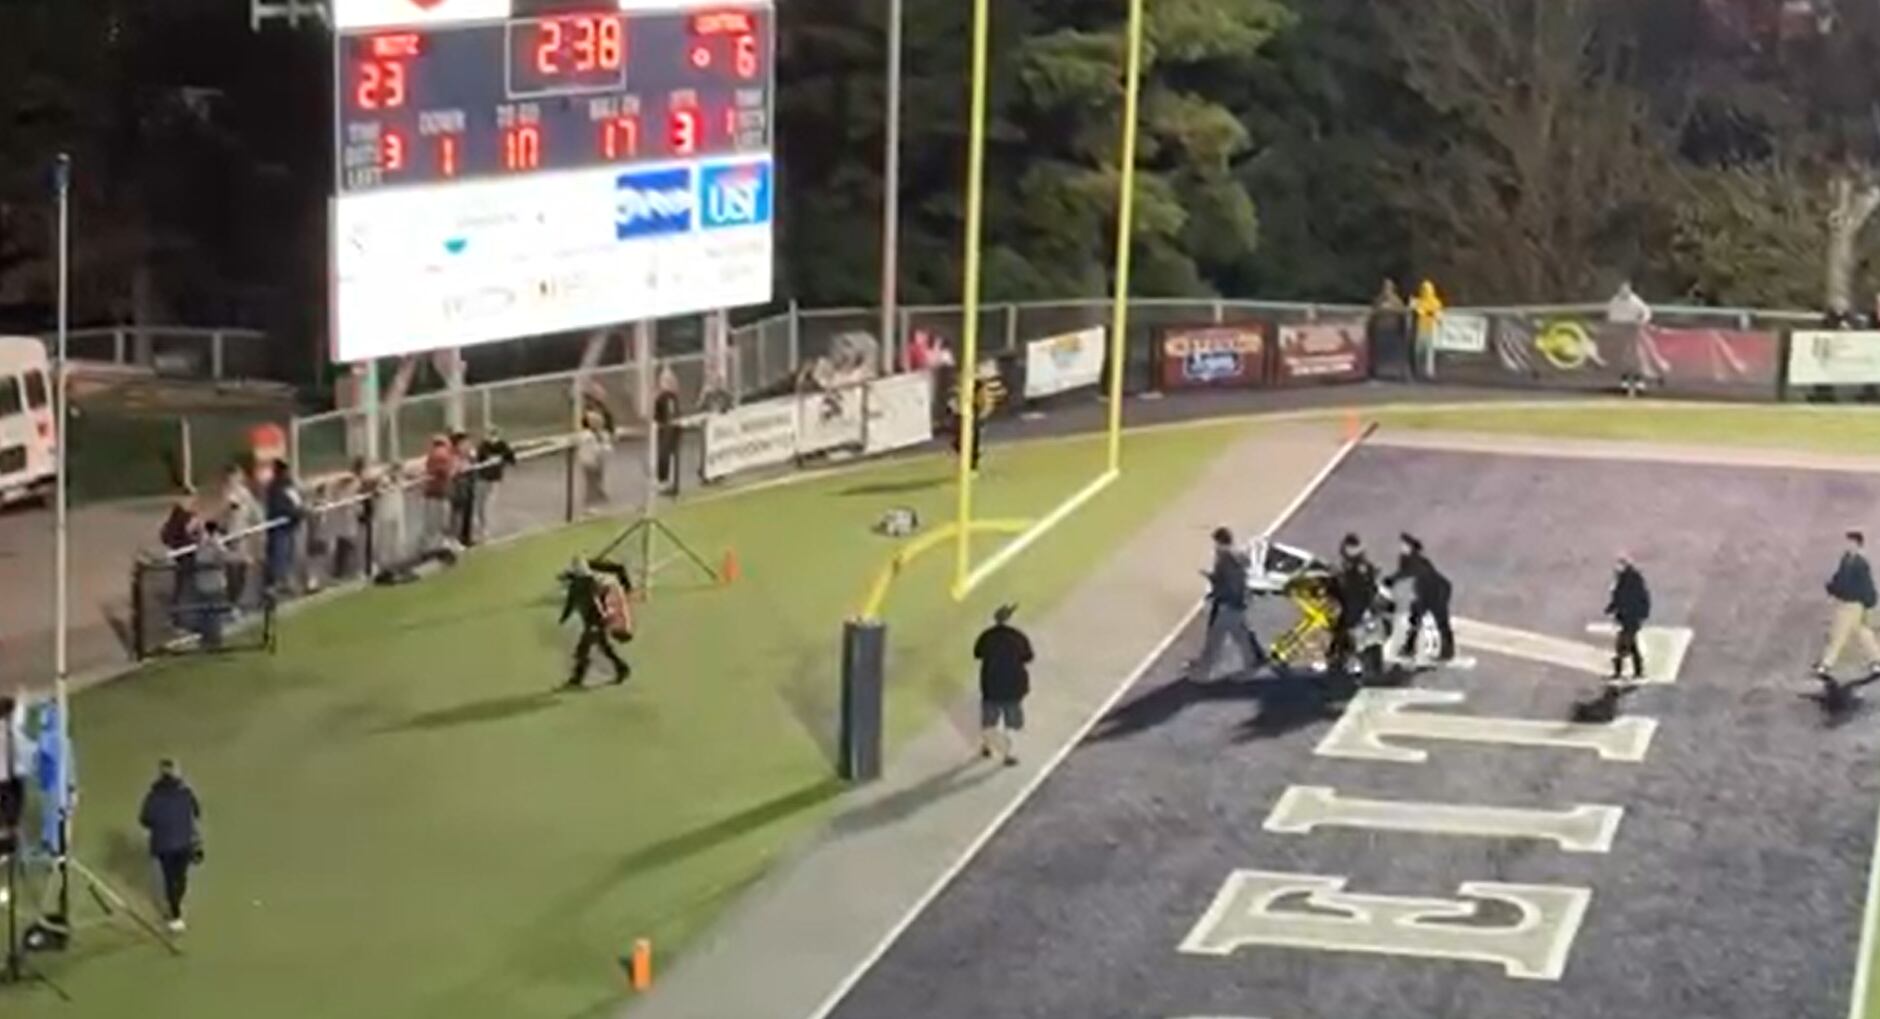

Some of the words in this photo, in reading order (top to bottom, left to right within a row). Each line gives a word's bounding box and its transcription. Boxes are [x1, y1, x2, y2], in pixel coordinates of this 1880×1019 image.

[538, 17, 620, 74] 2:38
[735, 35, 755, 78] 6
[358, 62, 404, 109] 23
[419, 110, 466, 136] DOWN
[605, 118, 637, 159] 17
[672, 112, 695, 154] 3
[384, 133, 402, 170] 3
[443, 138, 455, 176] 1
